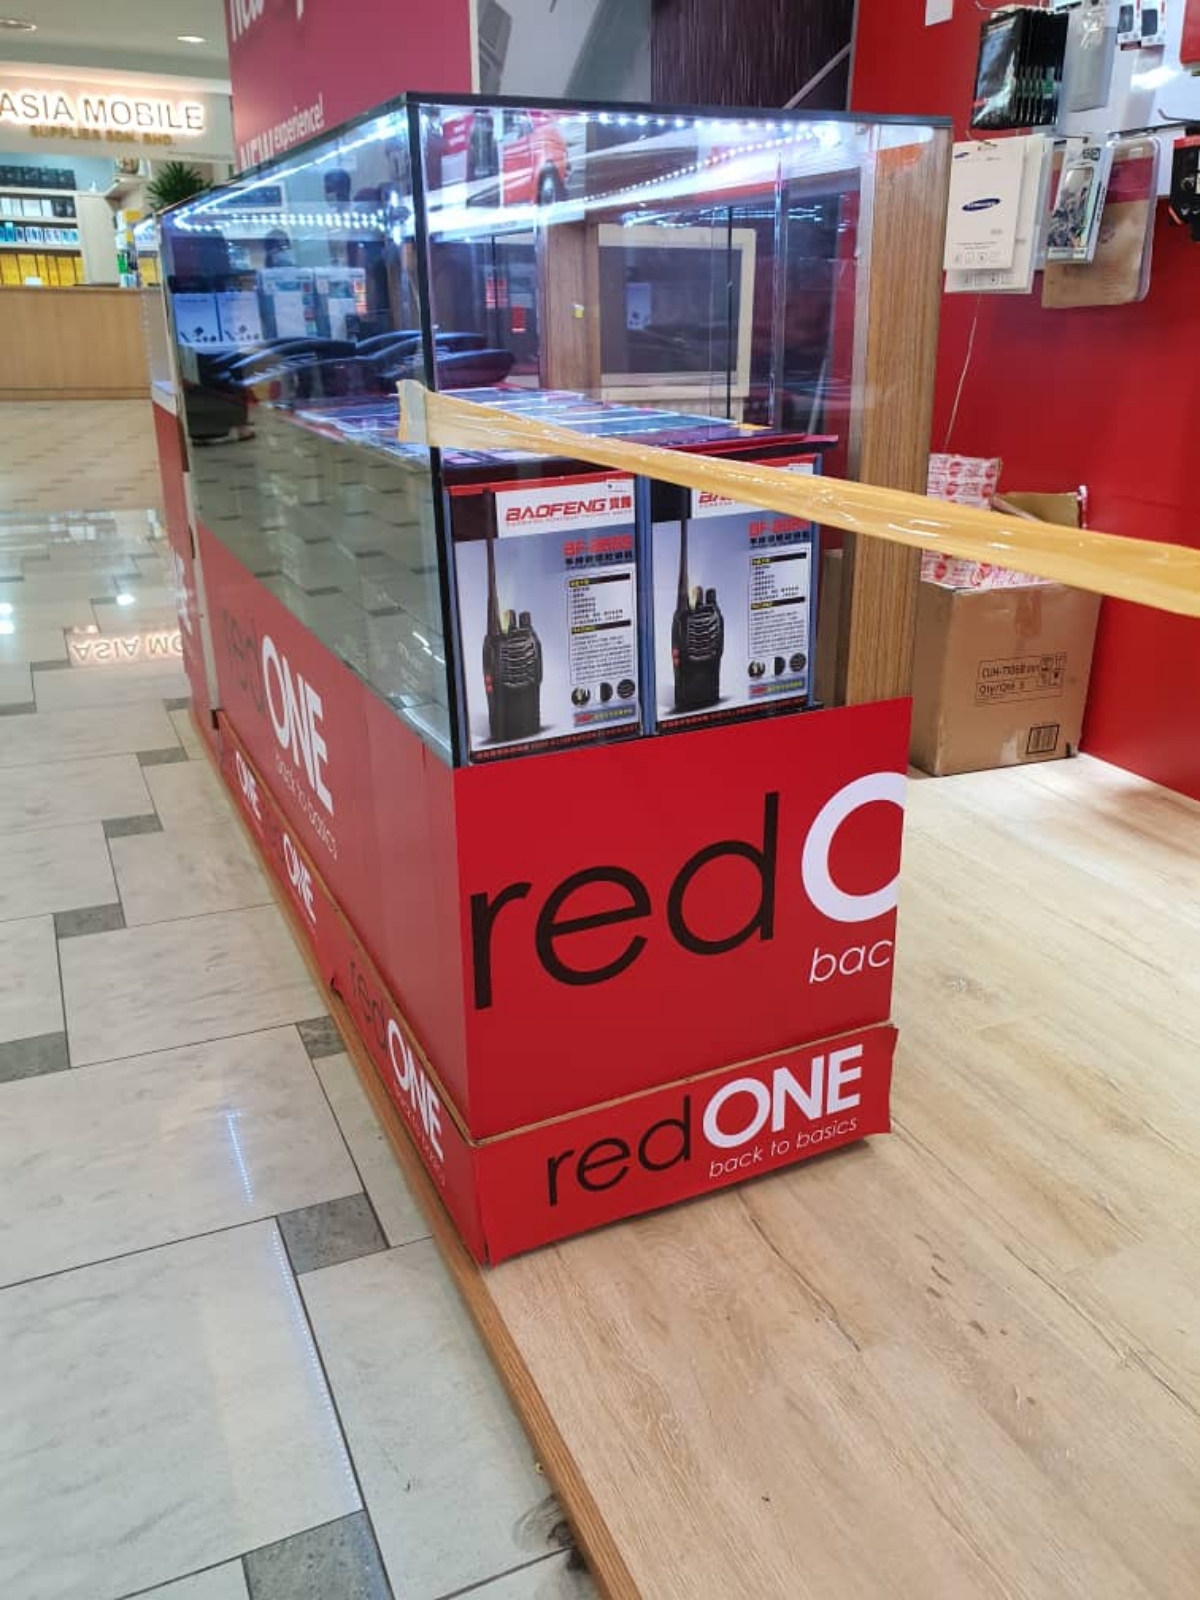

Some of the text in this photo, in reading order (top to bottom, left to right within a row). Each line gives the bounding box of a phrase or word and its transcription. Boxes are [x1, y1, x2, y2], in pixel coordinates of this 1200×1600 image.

[0, 92, 204, 130] ASIA MOBILE
[30, 125, 101, 141] SUPPLIES
[274, 92, 325, 149] experience!
[506, 497, 607, 522] BAOFENG
[546, 1044, 864, 1207] redONE
[708, 1117, 858, 1179] back to basics
